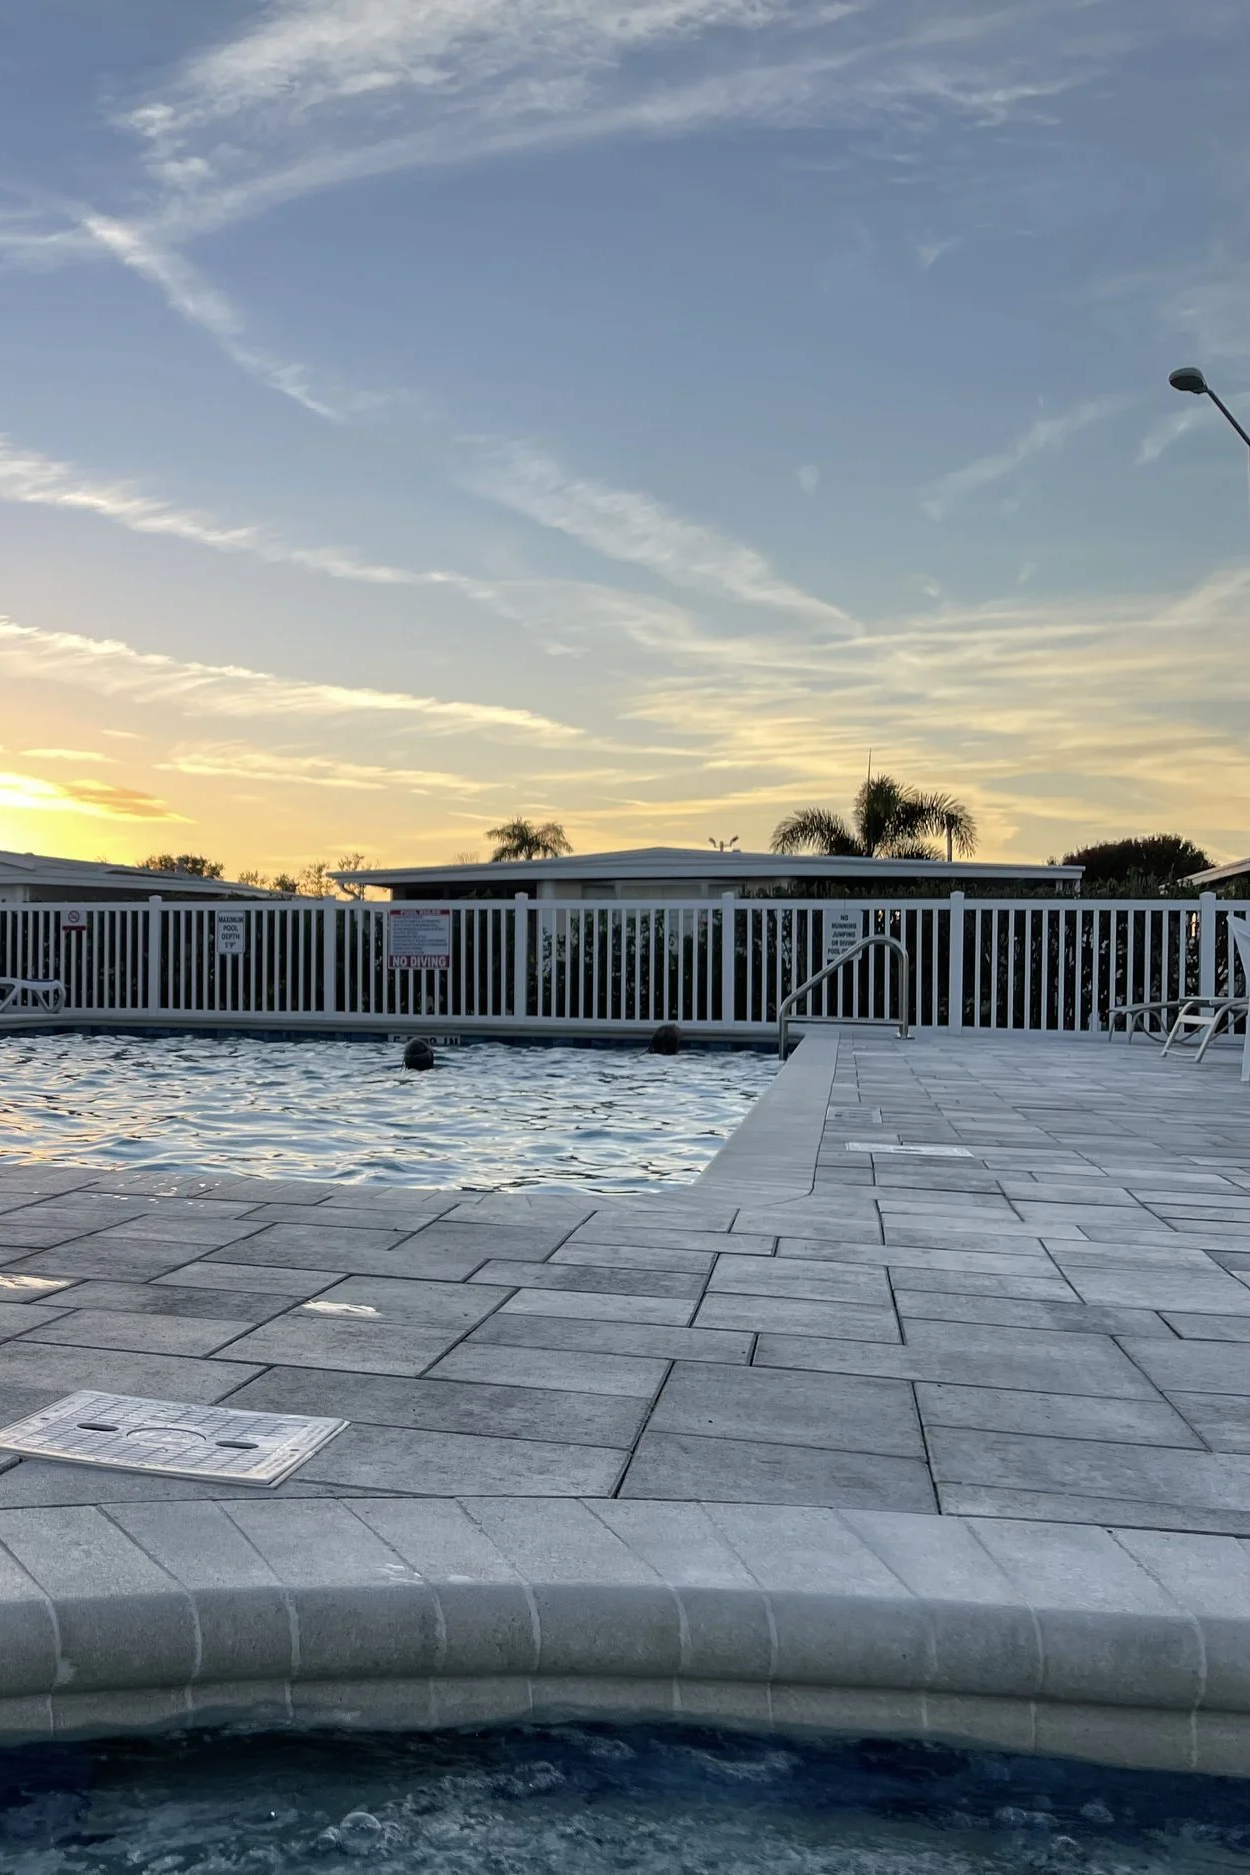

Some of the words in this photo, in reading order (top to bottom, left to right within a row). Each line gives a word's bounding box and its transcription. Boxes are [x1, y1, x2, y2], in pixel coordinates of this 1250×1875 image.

[223, 924, 239, 932] POOL
[221, 932, 240, 940] DEPTH
[392, 956, 408, 967] NO
[409, 956, 447, 967] DIVING
